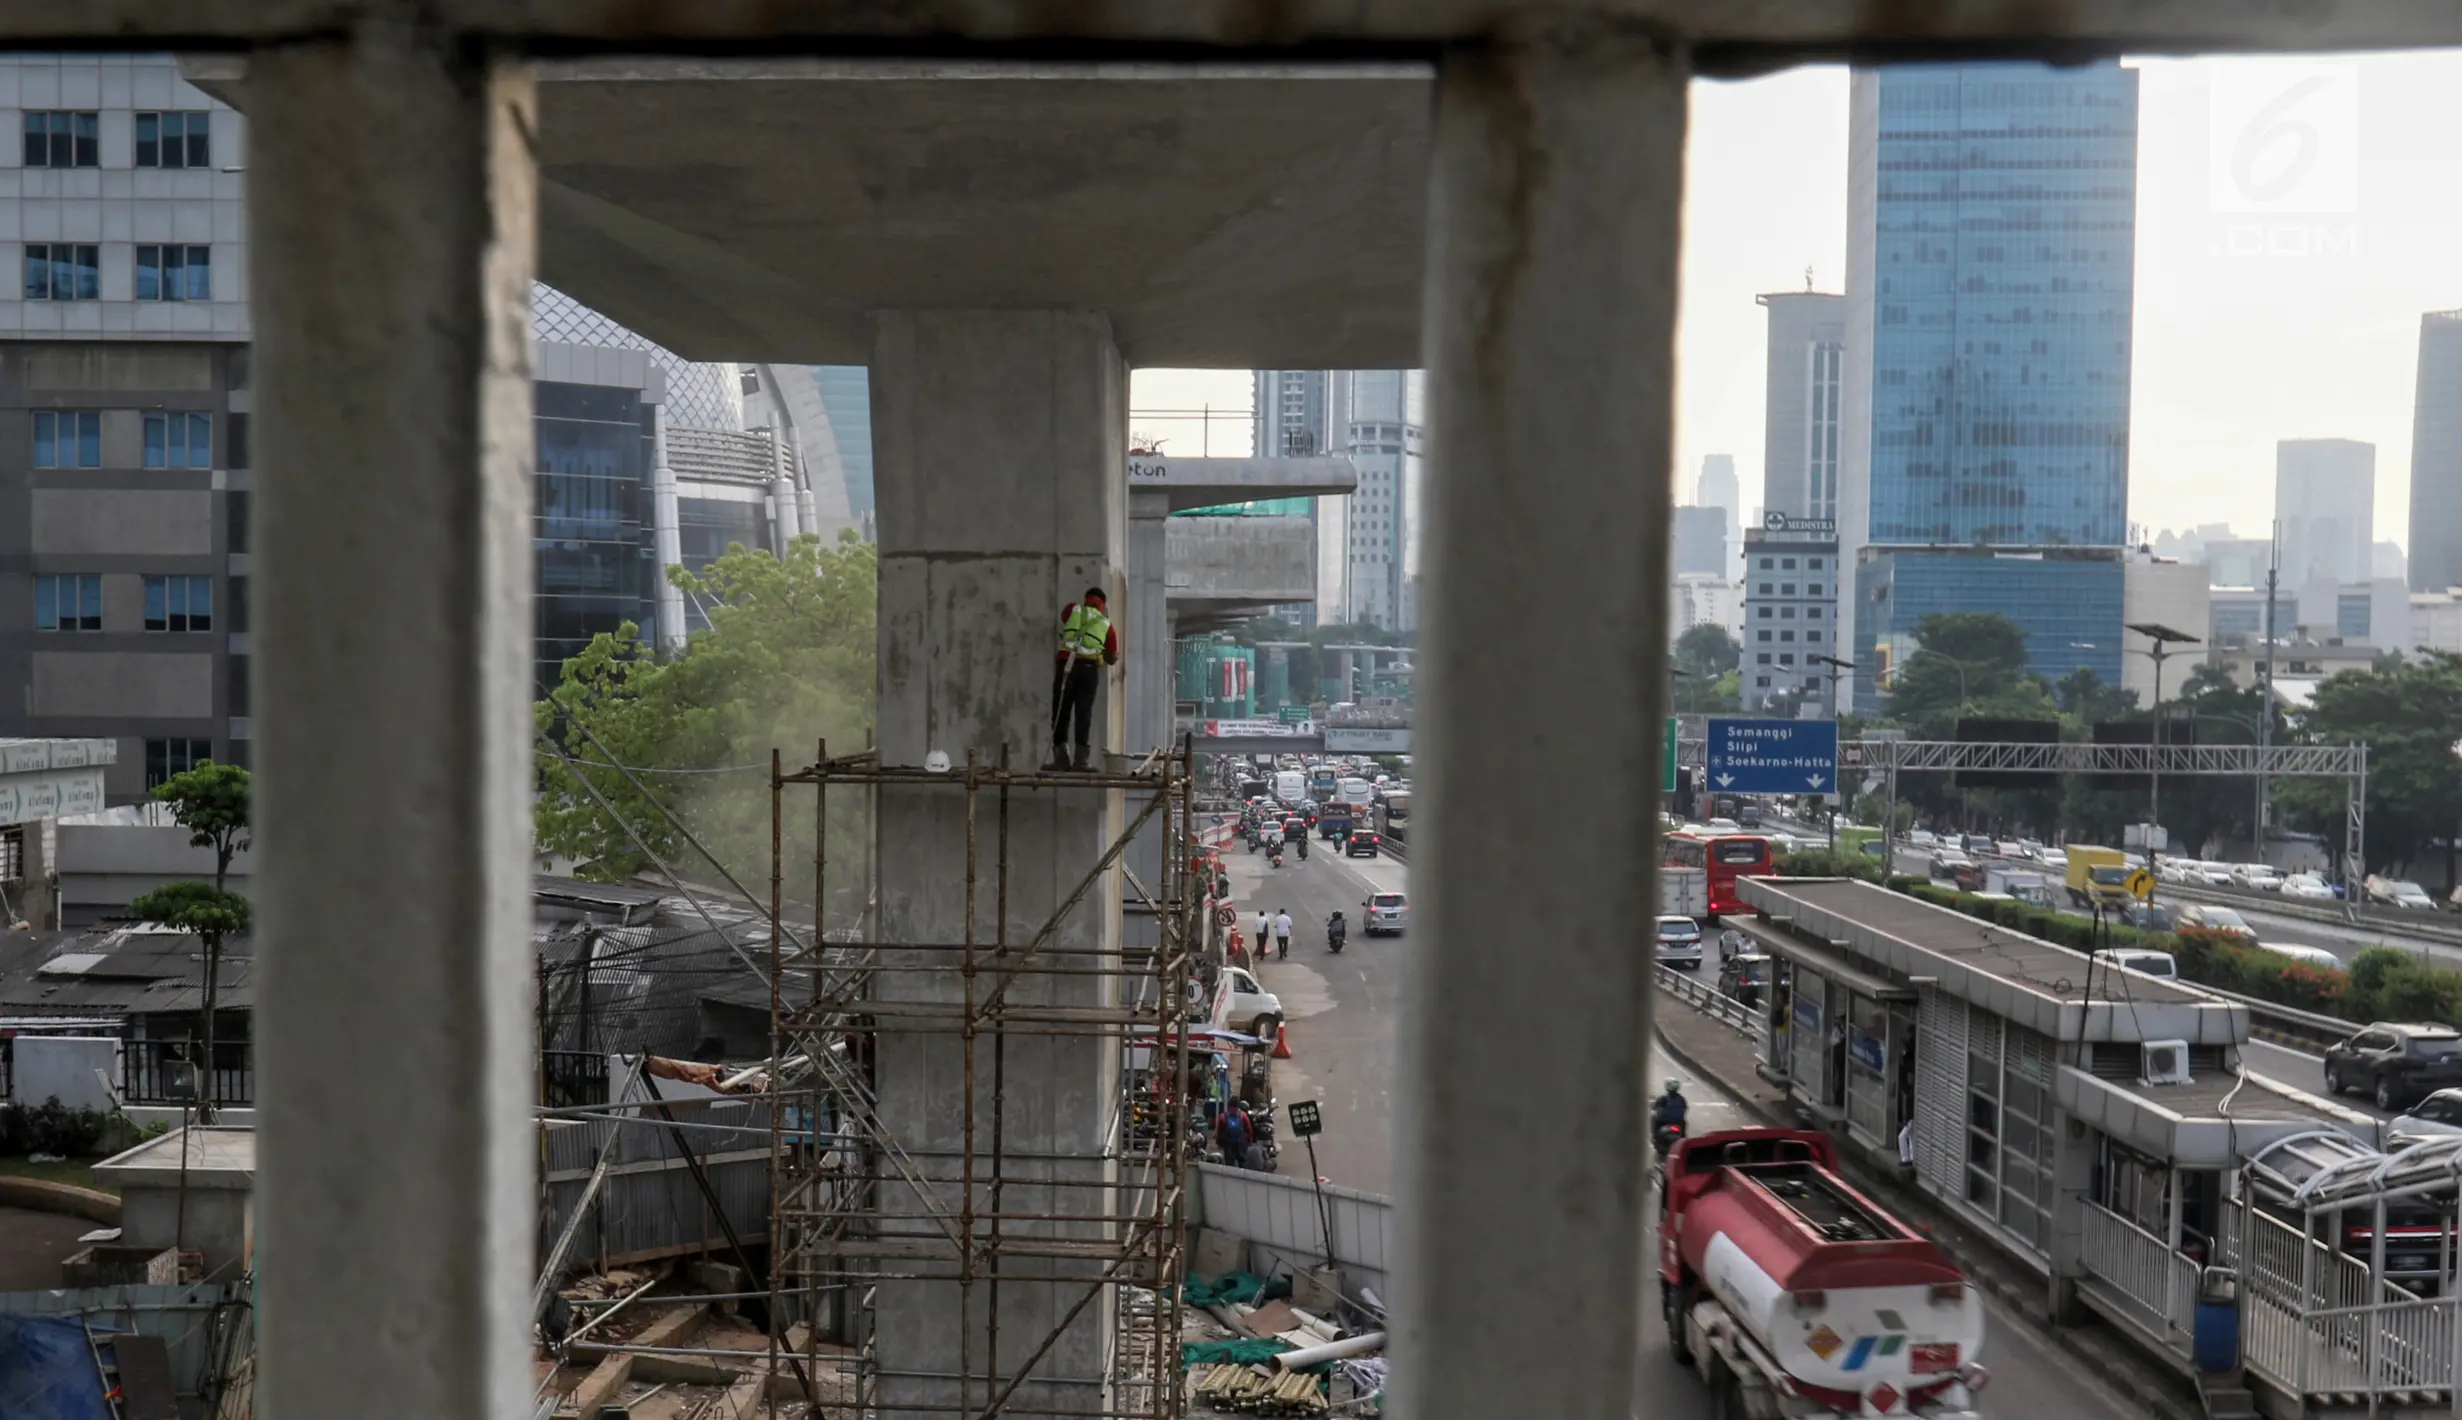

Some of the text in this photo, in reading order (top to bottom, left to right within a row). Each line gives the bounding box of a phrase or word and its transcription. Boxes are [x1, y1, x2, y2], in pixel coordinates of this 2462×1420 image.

[1787, 520, 1834, 530] MEDISTRA
[1727, 726, 1792, 740] Semanggi
[1727, 741, 1758, 753] Slipi
[1727, 755, 1832, 768] Soekarno-Hatta
